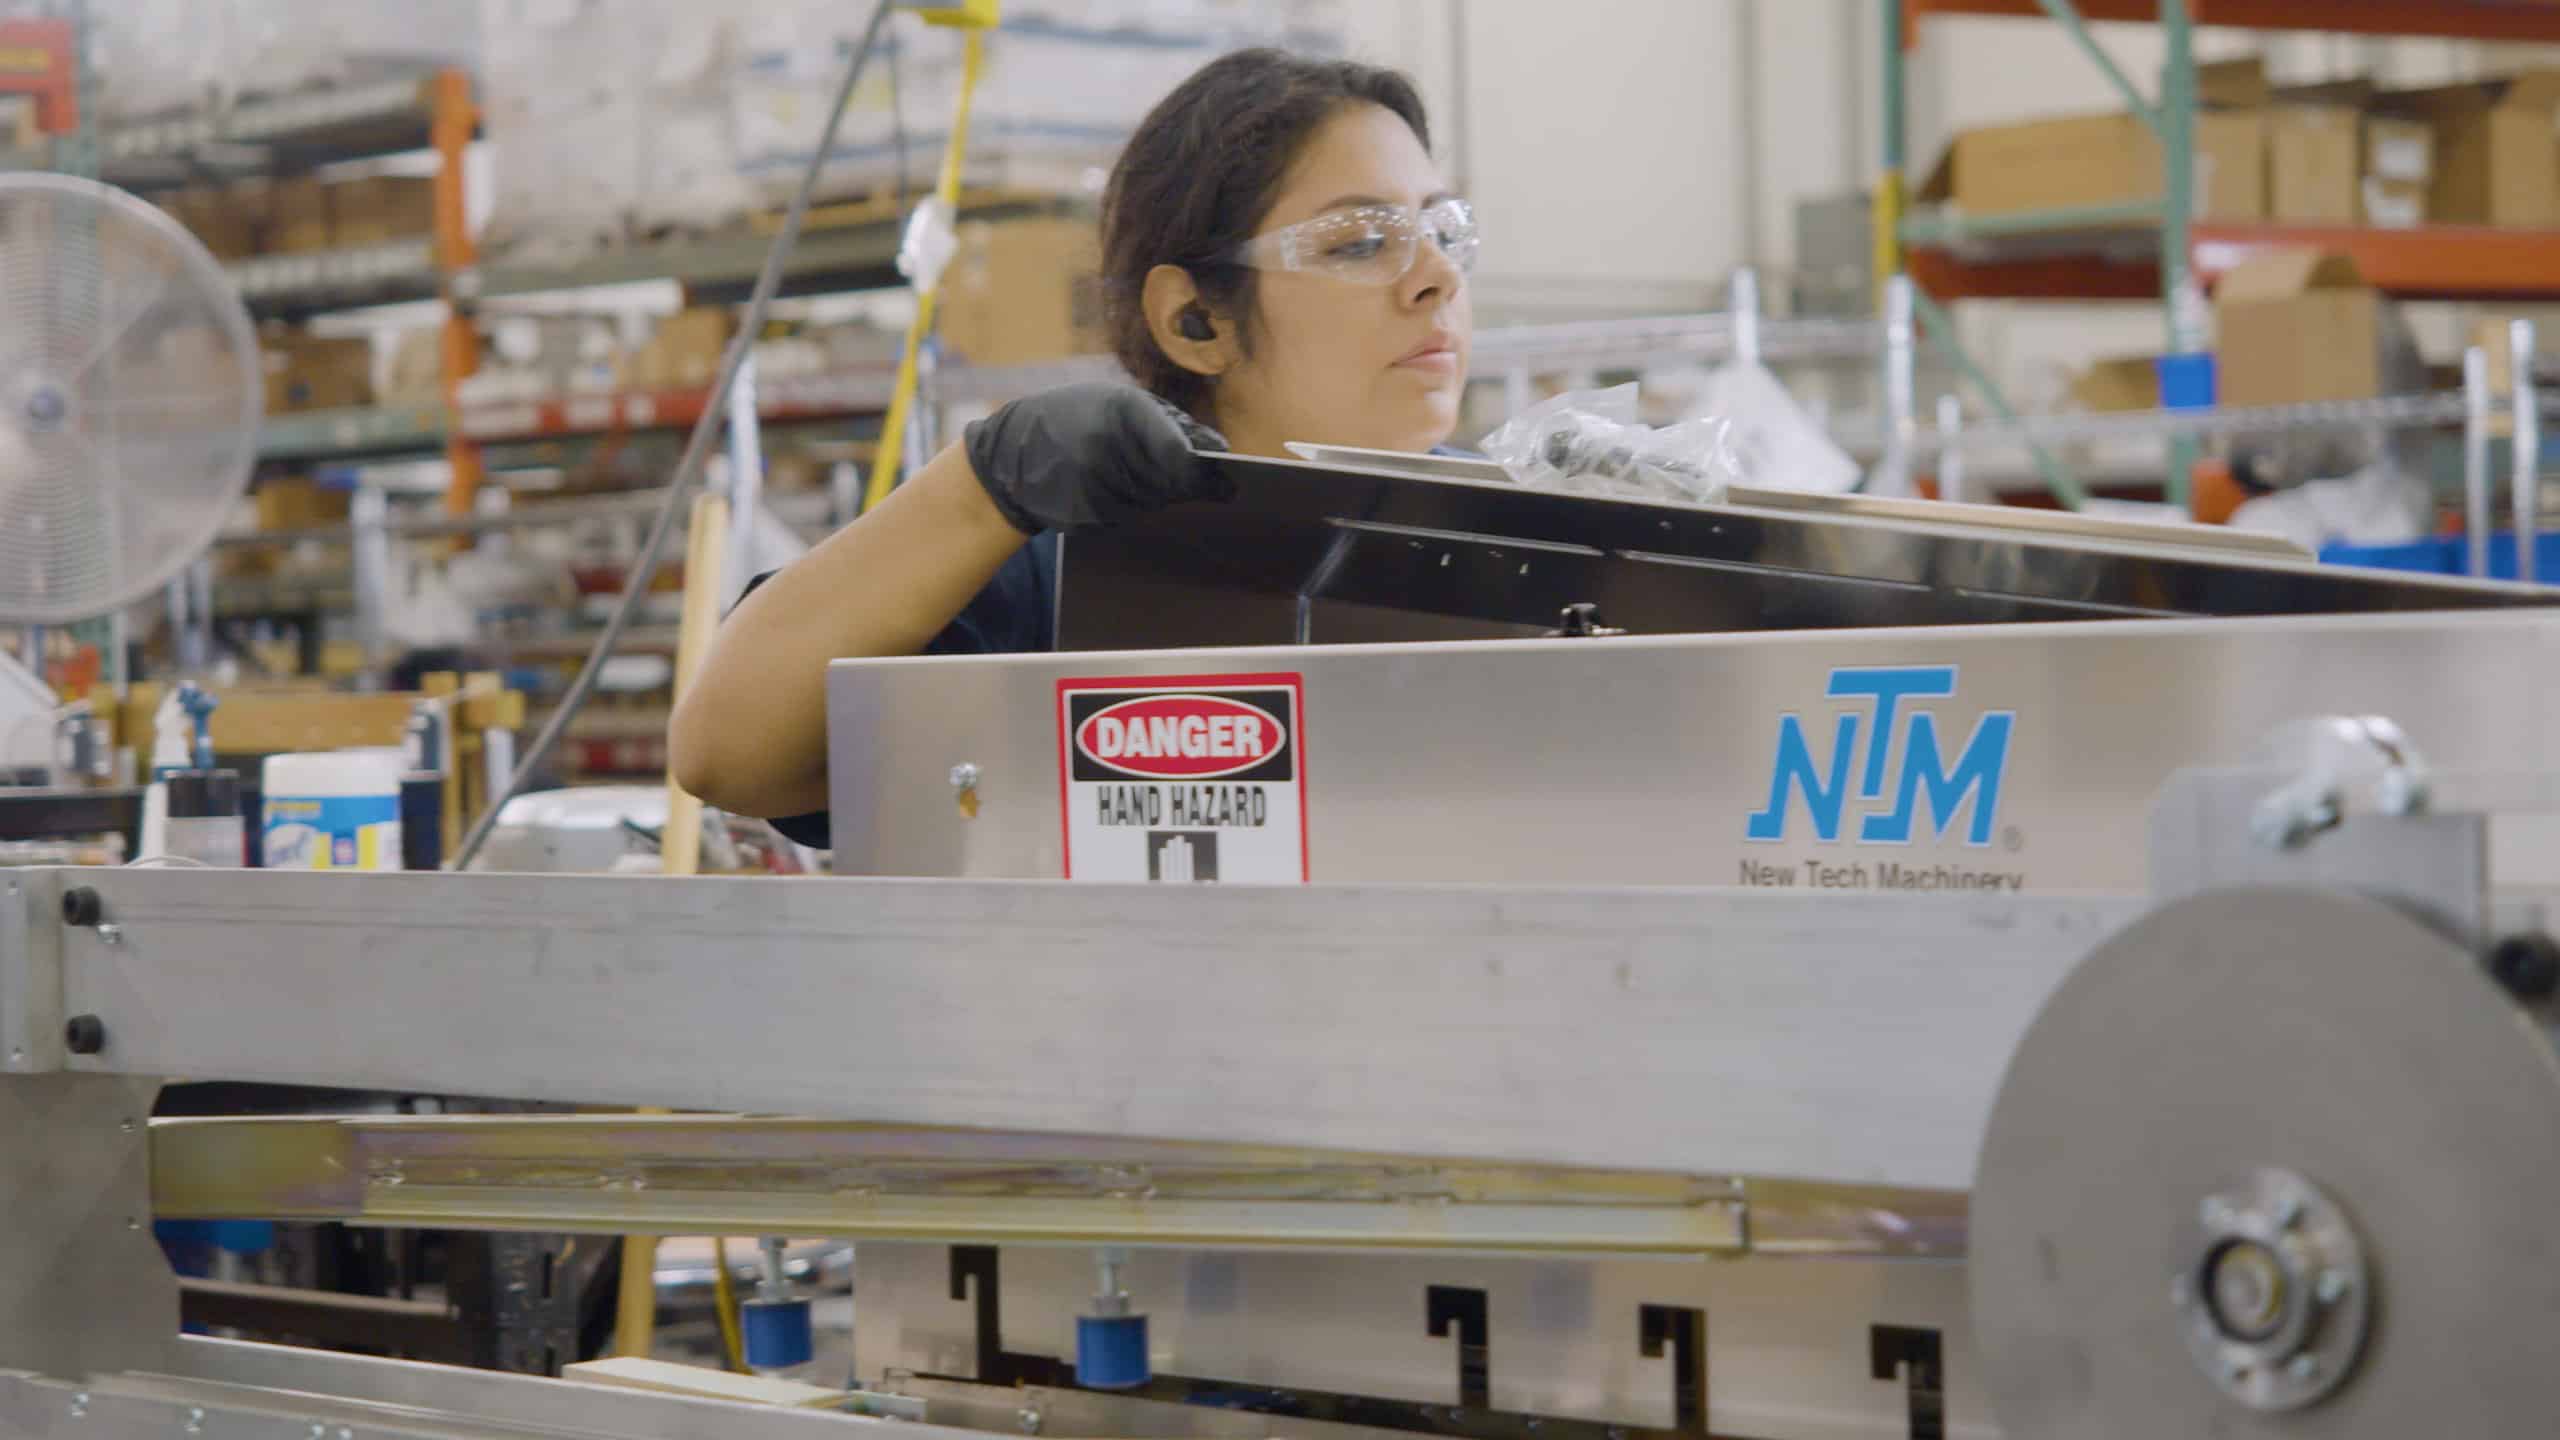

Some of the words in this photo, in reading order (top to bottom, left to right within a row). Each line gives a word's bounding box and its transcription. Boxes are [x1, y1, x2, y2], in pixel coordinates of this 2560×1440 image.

[1096, 715, 1264, 758] DANGER
[1746, 664, 2016, 847] NTM
[1097, 785, 1161, 827] HAND
[1171, 785, 1266, 827] HAZARD
[1739, 859, 1796, 888] New
[1804, 860, 1868, 889] Tech
[1878, 862, 2024, 891] Machinery
